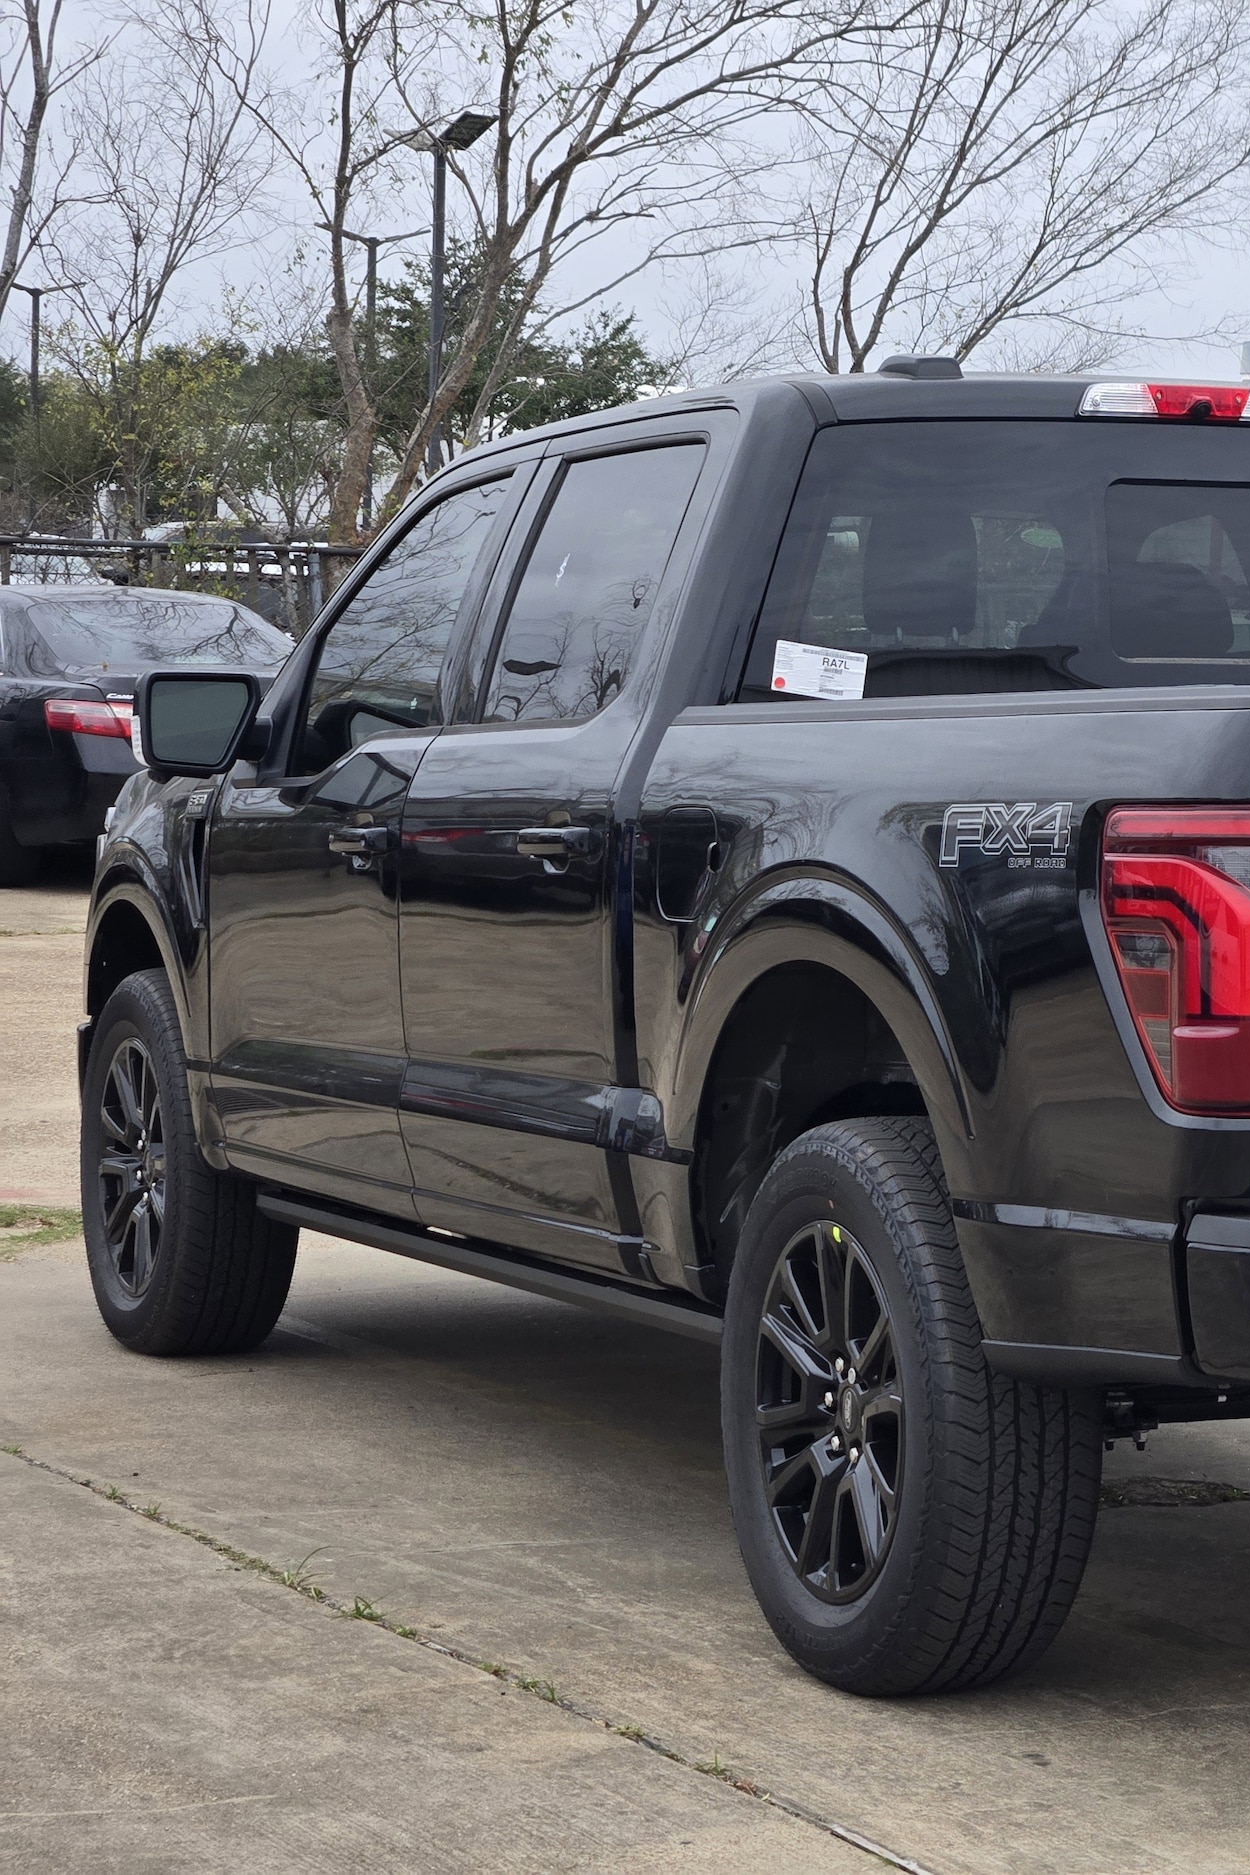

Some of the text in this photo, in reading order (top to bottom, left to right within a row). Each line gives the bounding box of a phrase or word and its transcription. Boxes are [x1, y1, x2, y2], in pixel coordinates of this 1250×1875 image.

[822, 657, 850, 670] RA7L
[939, 802, 1073, 867] FX4
[1008, 857, 1066, 869] OFF ROAD
